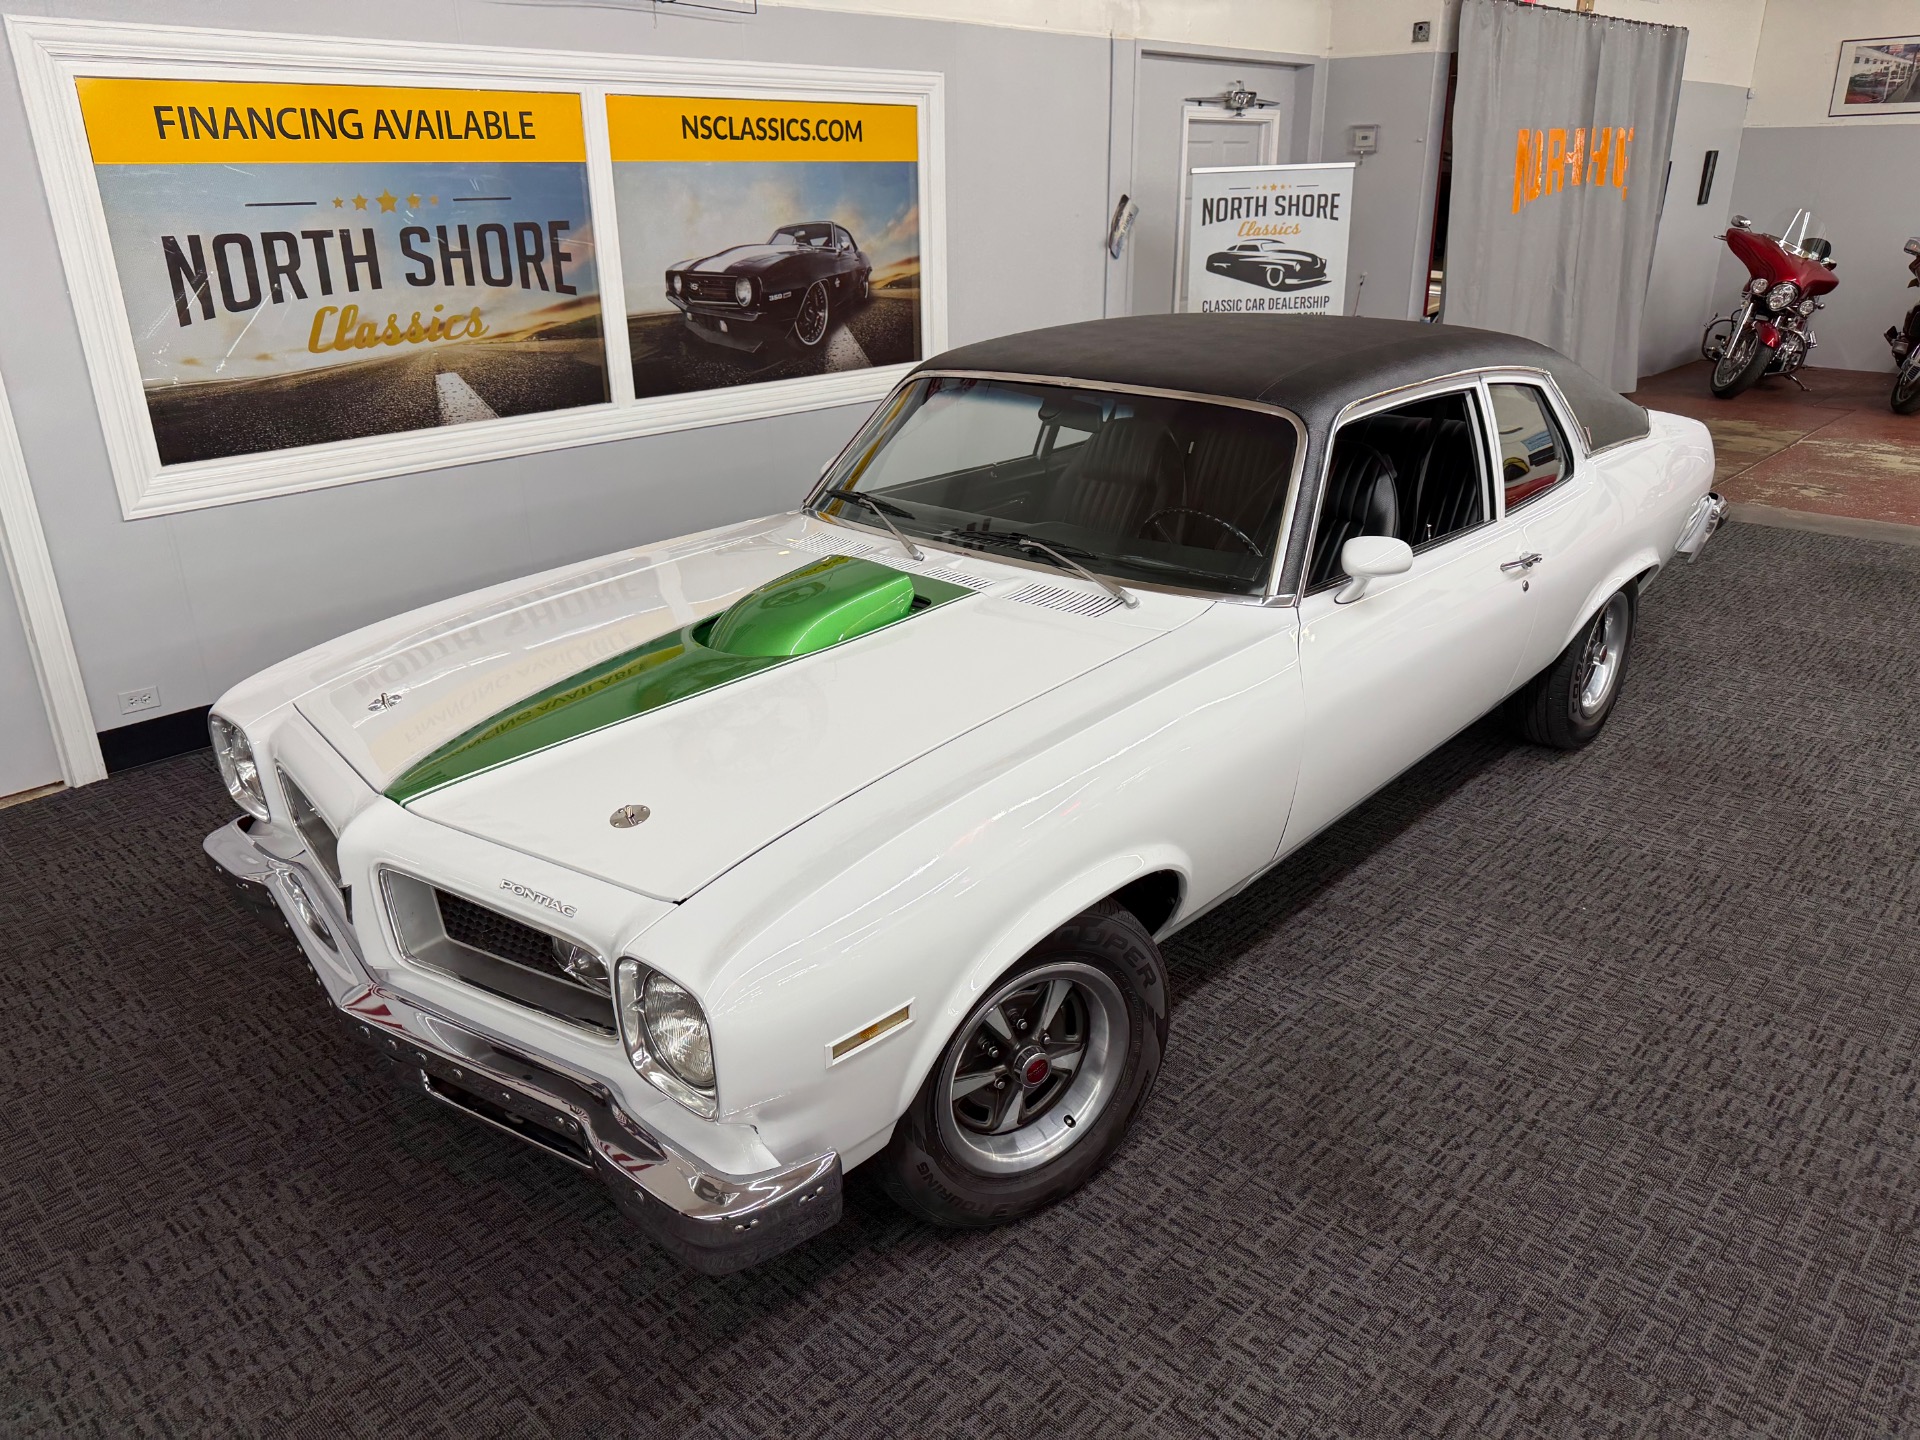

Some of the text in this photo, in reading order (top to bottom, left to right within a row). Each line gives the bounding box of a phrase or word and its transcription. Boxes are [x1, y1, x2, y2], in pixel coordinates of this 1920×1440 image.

[153, 105, 536, 141] FINANCING AVAILABLE
[681, 114, 863, 143] NSCLASSICS.COM
[1202, 193, 1341, 226] NORTH SHORE
[1237, 221, 1301, 237] Classics
[161, 220, 578, 328] NORTH SHORE
[1202, 295, 1330, 313] CLASSIC CAR DEALERSHIP
[307, 303, 490, 354] Classics
[500, 879, 577, 918] PONTIAC
[915, 1161, 985, 1215] TOURING
